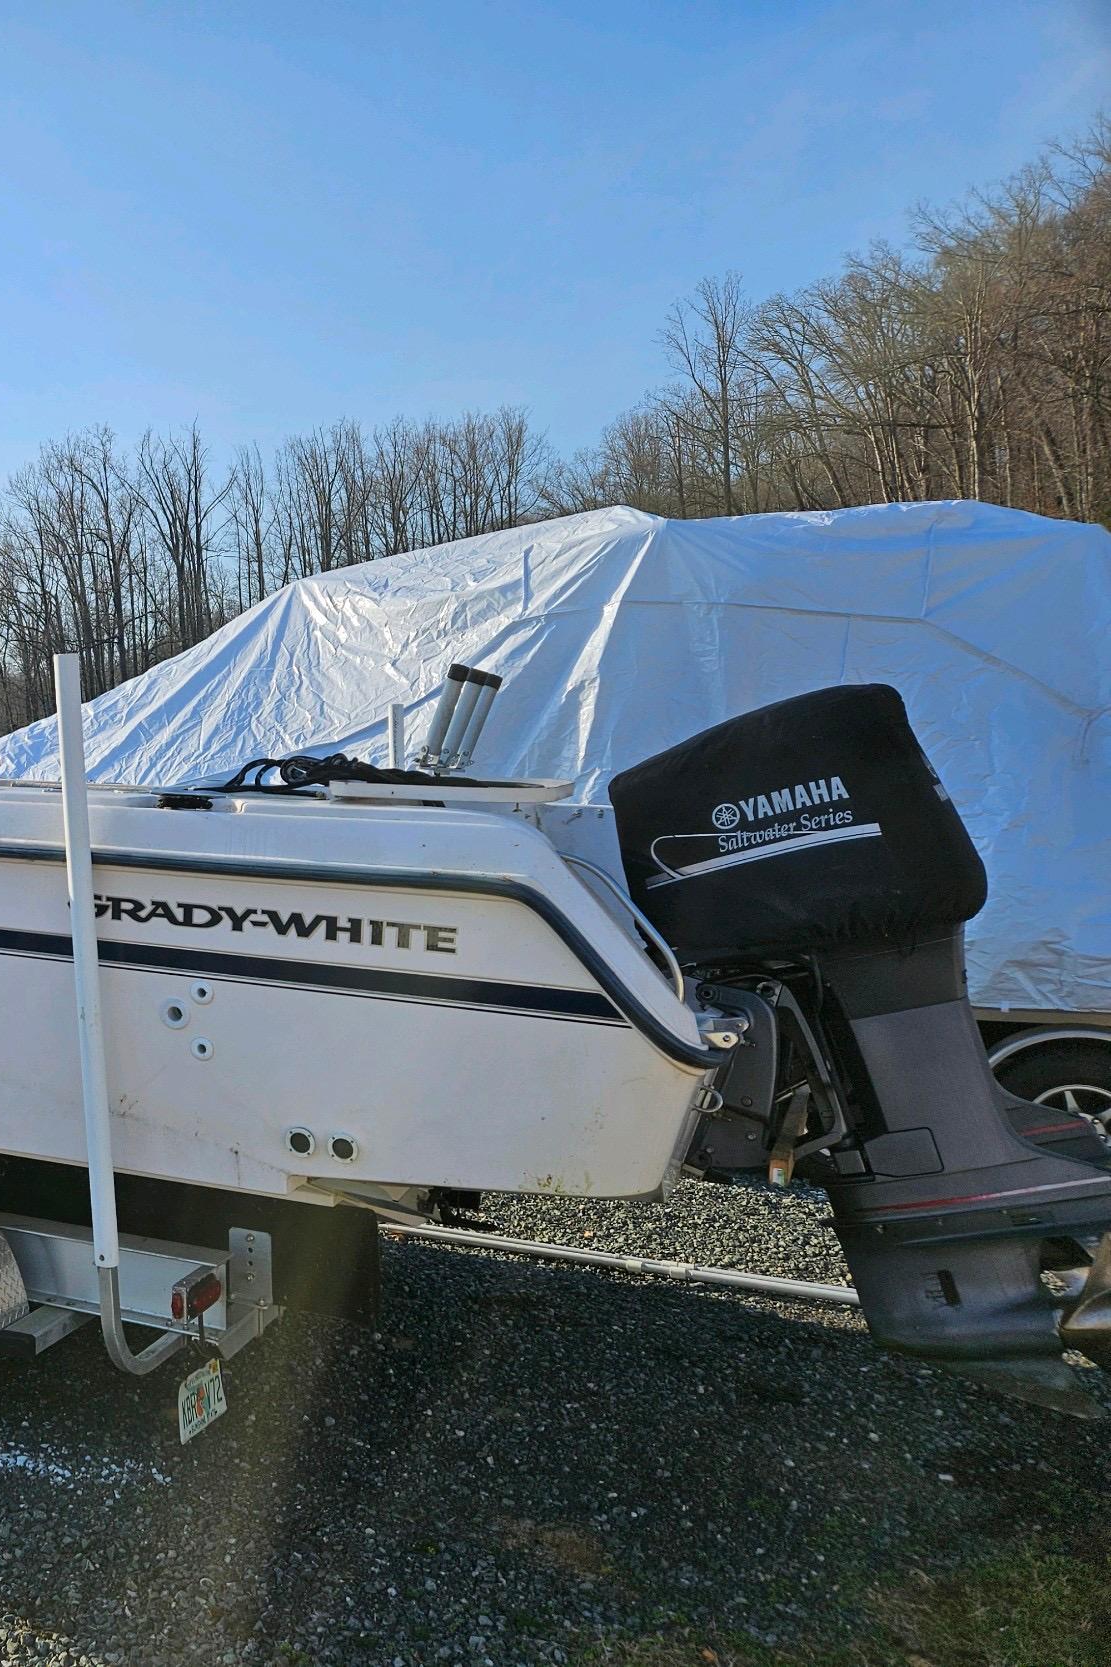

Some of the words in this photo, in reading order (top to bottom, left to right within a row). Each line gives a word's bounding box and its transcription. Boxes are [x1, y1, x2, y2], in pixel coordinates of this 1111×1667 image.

[739, 776, 850, 822] YAMAHA
[718, 819, 796, 852] Saltwater
[800, 809, 853, 832] Series
